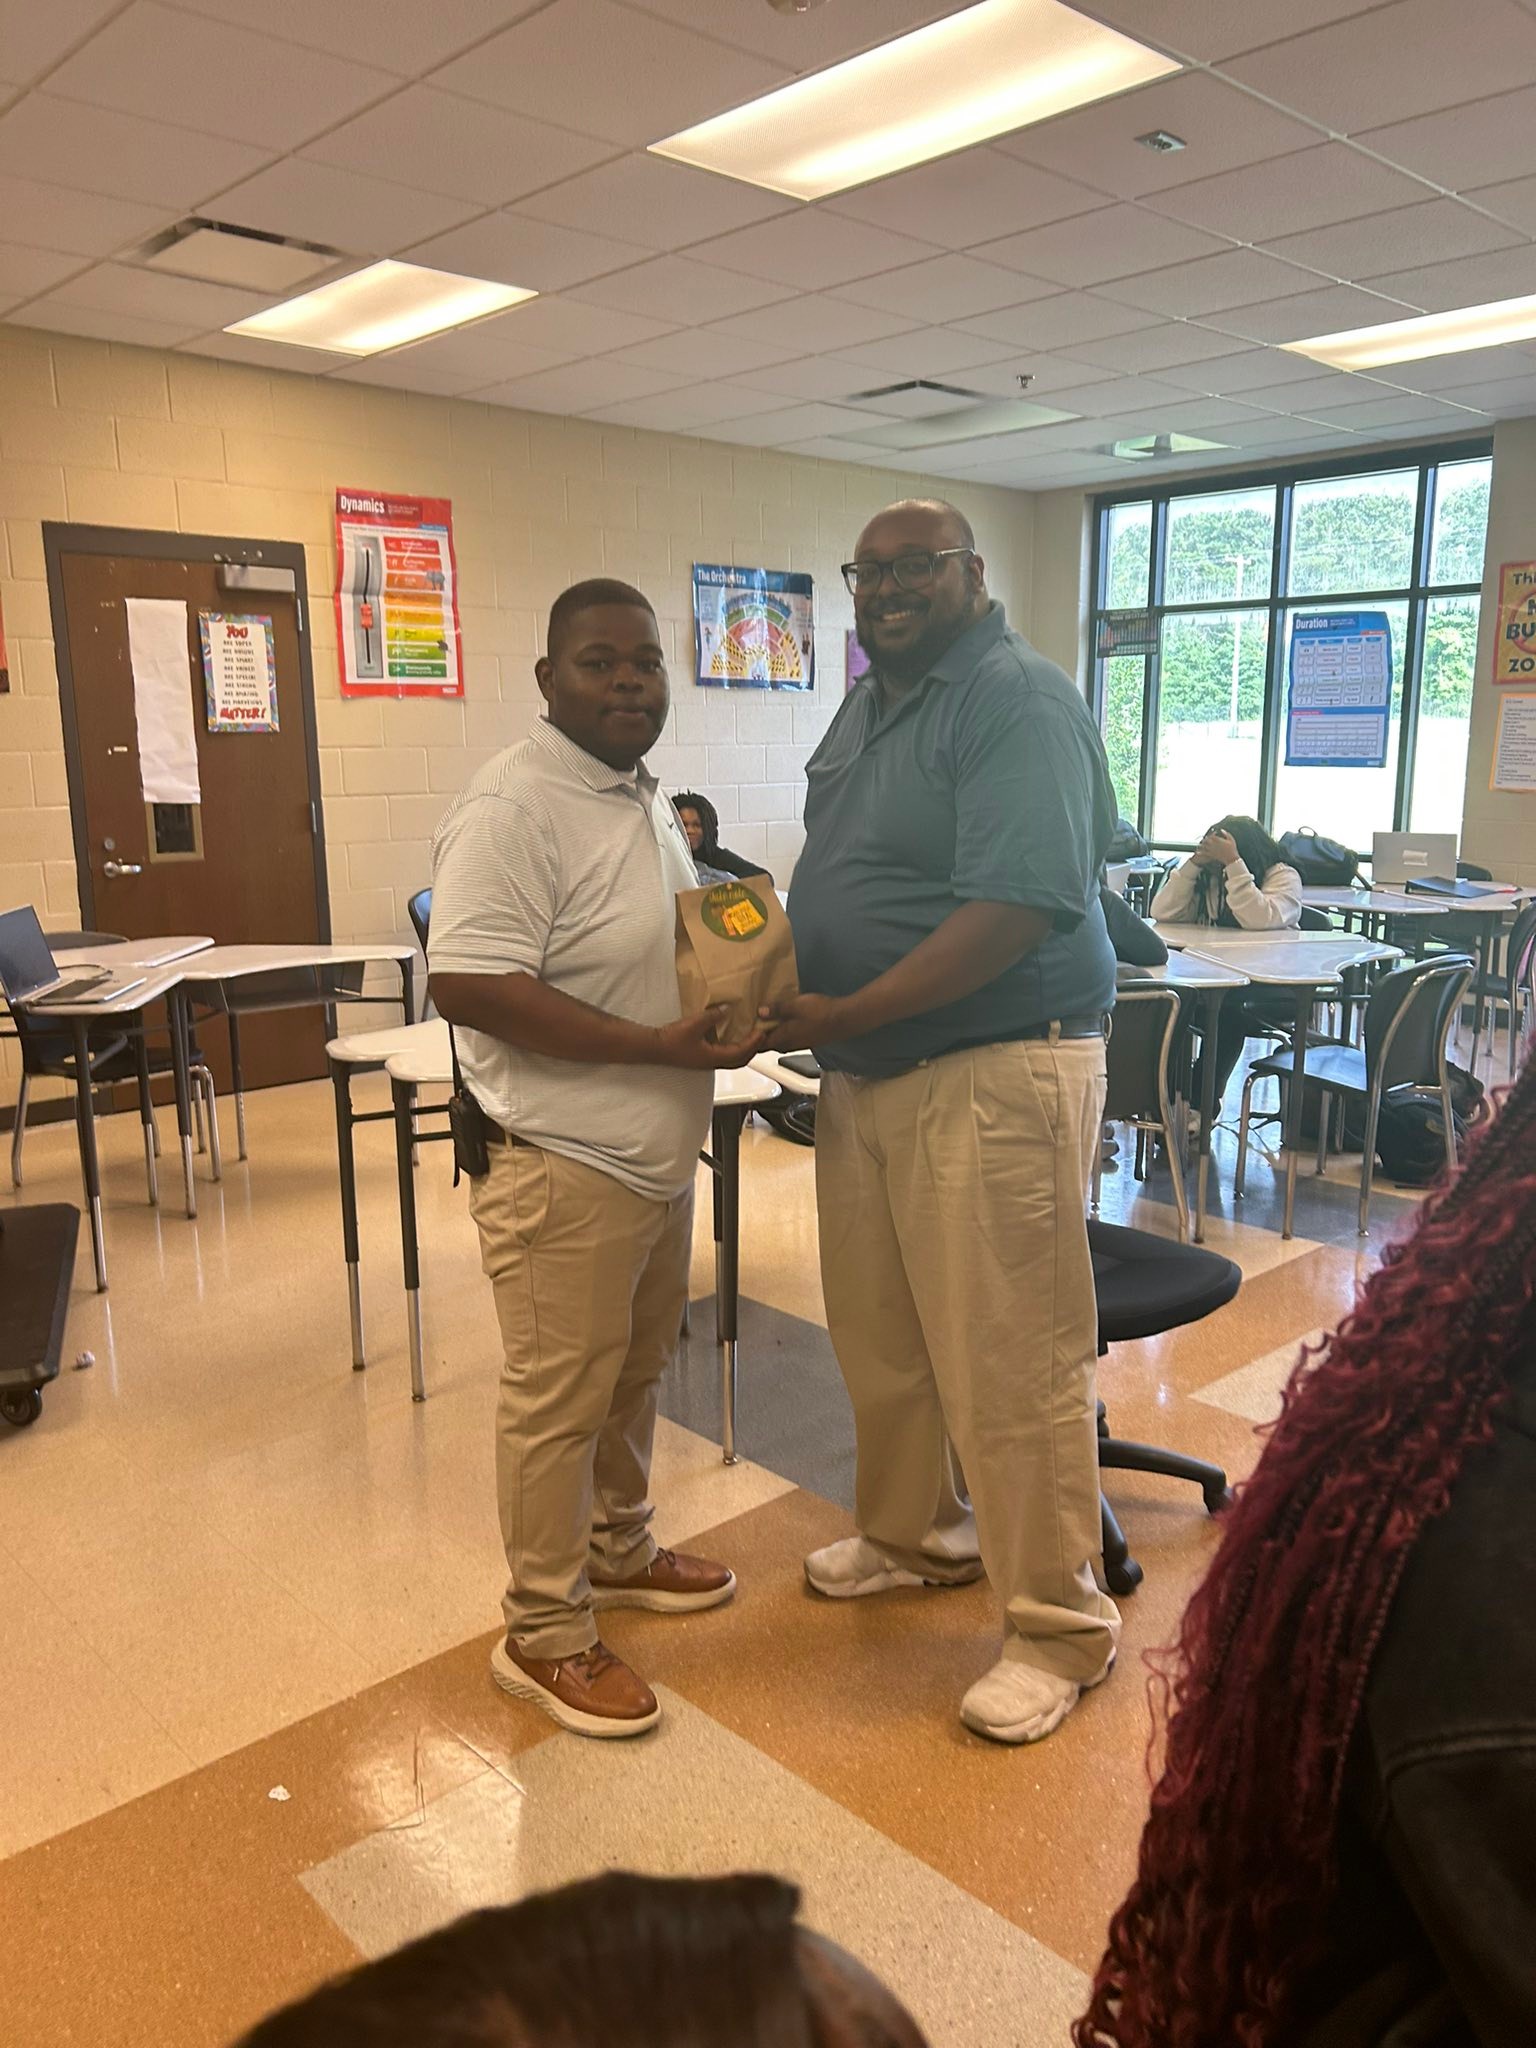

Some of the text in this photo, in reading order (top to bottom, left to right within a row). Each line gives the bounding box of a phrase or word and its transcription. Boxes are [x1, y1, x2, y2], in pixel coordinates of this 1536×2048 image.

[340, 495, 385, 513] Dynamics
[698, 569, 746, 585] The Orchetra
[1295, 617, 1328, 630] Duration
[225, 624, 249, 639] YOU
[220, 707, 266, 720] MATTER!
